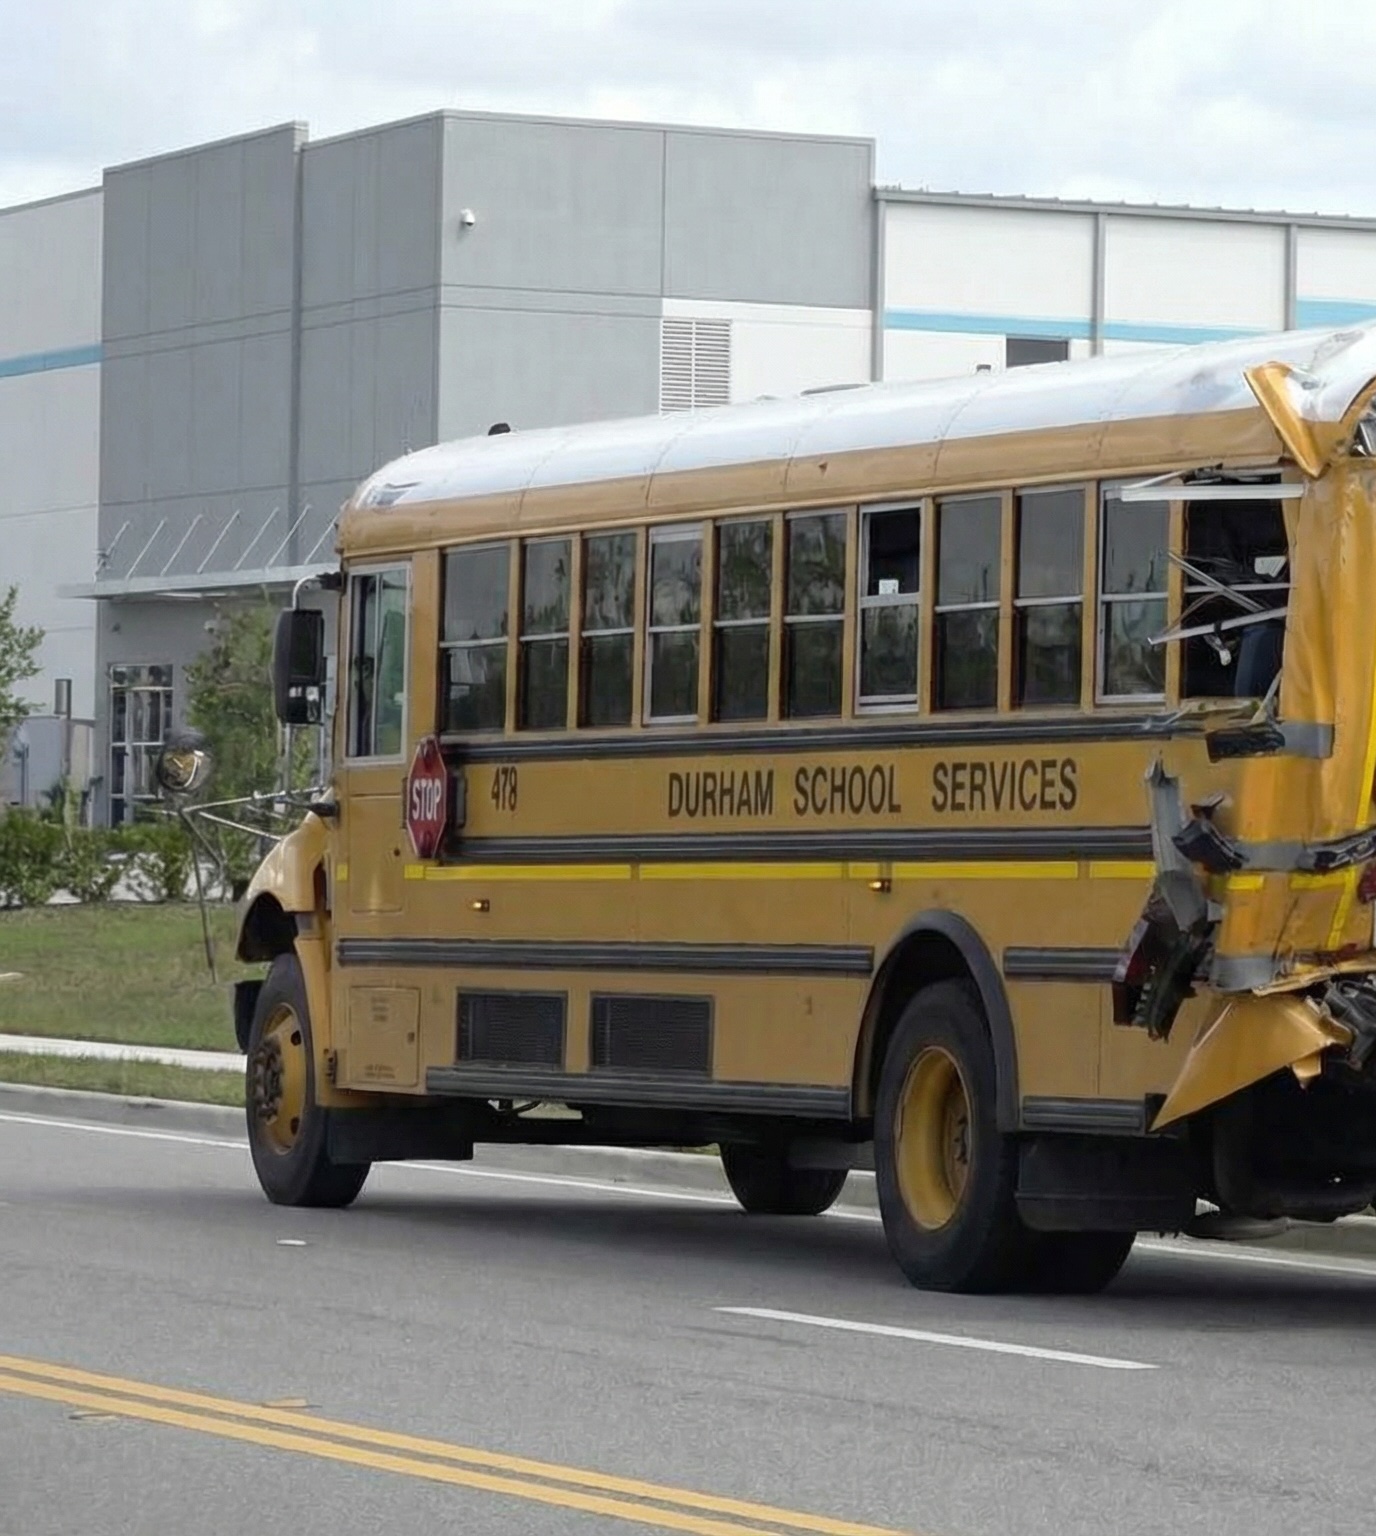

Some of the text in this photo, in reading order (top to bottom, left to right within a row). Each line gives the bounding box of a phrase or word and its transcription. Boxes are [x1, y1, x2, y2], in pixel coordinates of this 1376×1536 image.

[411, 778, 442, 821] STOP
[667, 757, 1078, 818] DURHAM SCHOOL SERVICES
